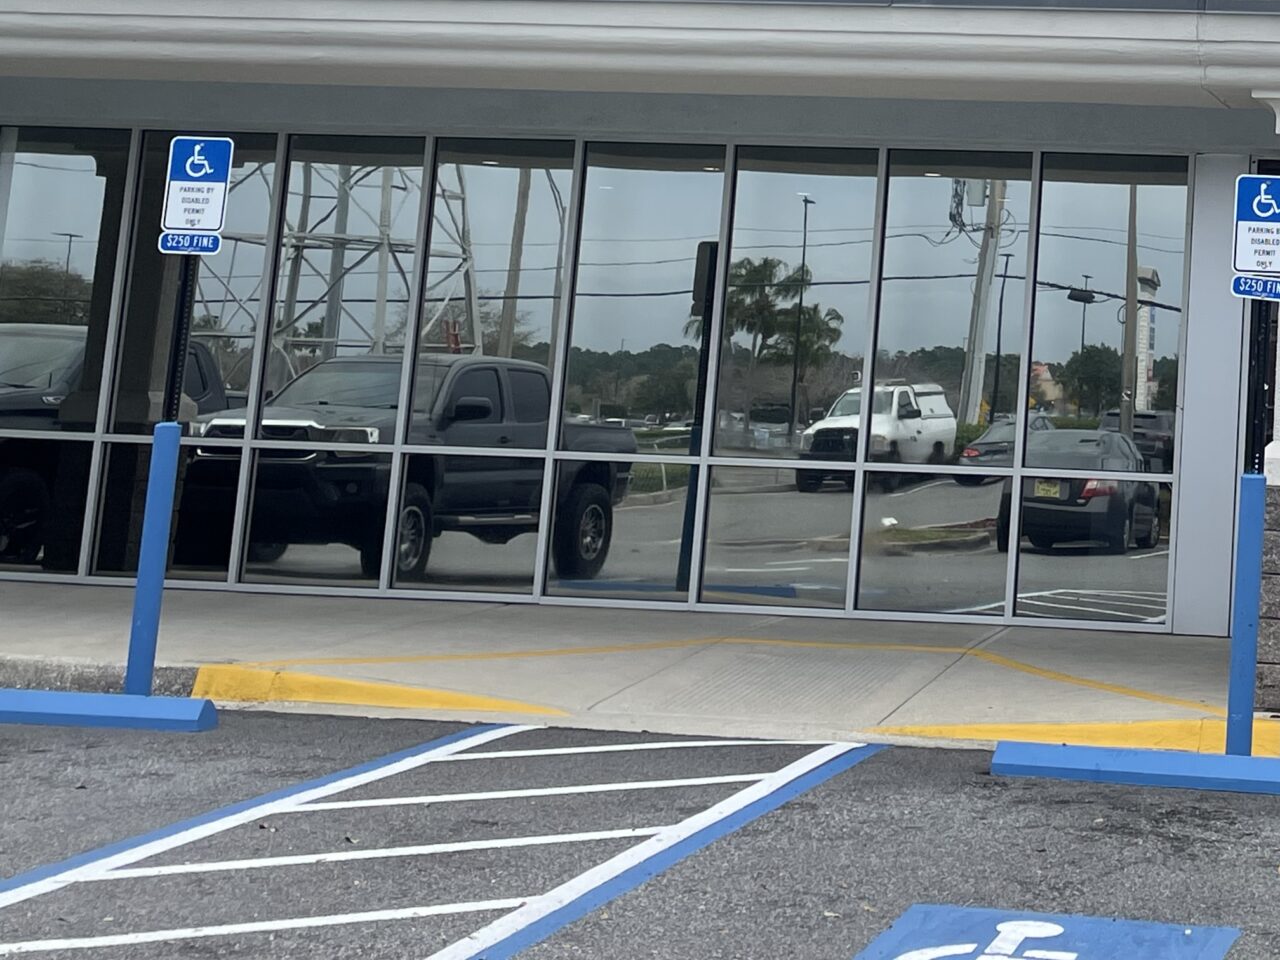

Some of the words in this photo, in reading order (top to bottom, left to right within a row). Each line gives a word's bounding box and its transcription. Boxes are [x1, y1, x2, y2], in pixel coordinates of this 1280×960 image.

[166, 234, 190, 248] $250
[192, 235, 214, 248] FINE
[1256, 260, 1273, 268] ONLY
[1239, 277, 1263, 292] $250
